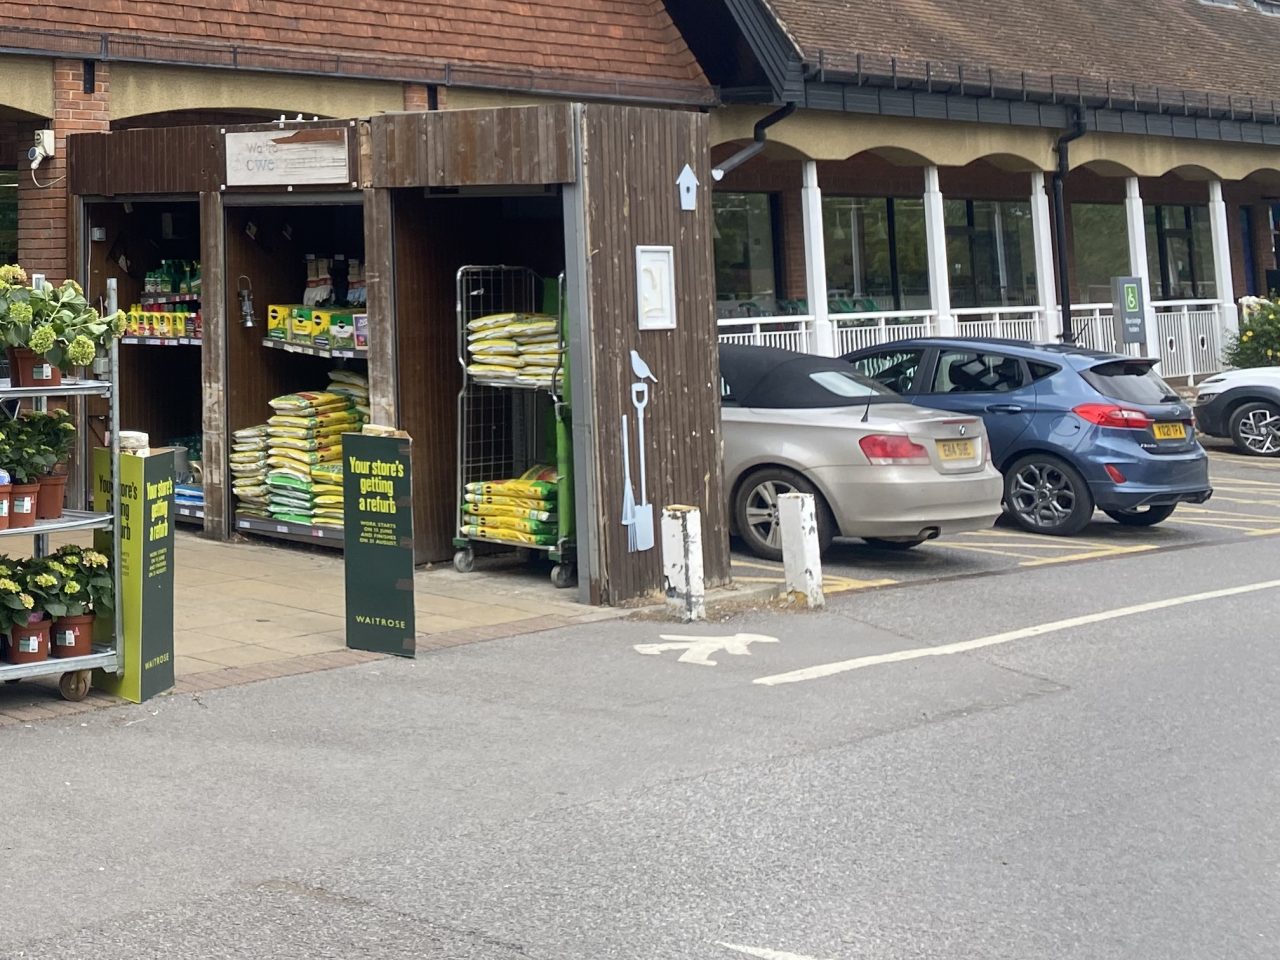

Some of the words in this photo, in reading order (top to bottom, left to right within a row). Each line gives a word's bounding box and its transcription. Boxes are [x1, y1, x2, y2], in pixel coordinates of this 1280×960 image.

[349, 456, 371, 474] Your
[372, 459, 404, 477] store's
[360, 476, 394, 496] getting
[359, 497, 365, 511] a
[366, 496, 396, 514] refurb
[355, 615, 406, 629] WAITROSE
